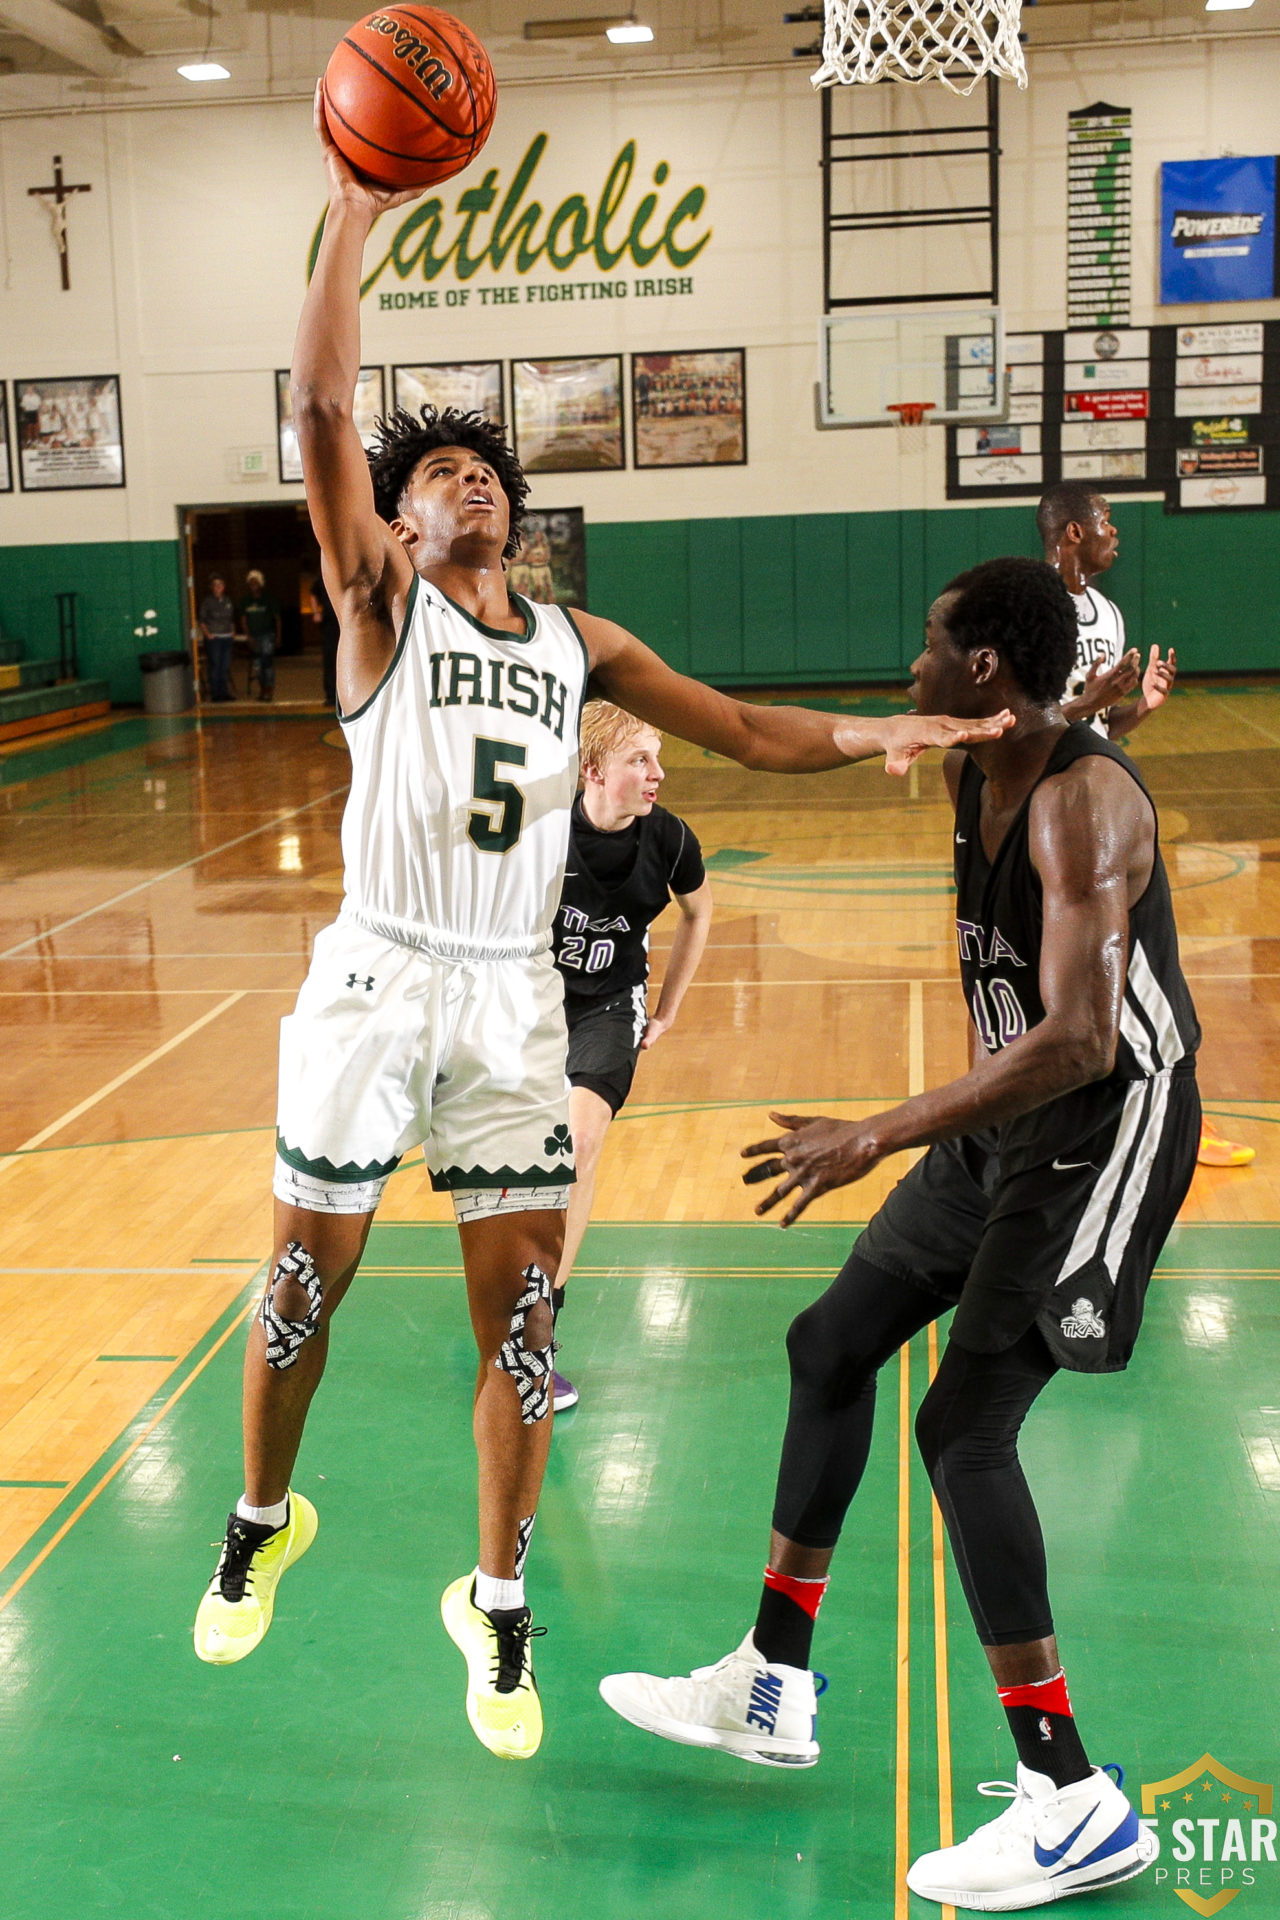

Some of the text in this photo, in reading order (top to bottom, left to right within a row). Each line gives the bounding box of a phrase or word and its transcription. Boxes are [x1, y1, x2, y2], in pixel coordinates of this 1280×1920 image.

[364, 14, 453, 103] Wilson
[306, 131, 713, 303] atholic
[379, 277, 693, 311] HOME OF THE FIGHTING IRISH
[429, 651, 567, 742] IRISH
[465, 734, 529, 856] 5
[558, 936, 615, 974] 20
[973, 978, 1027, 1049] 10
[1061, 1322, 1101, 1338] TKA
[745, 1669, 784, 1736] NIKE
